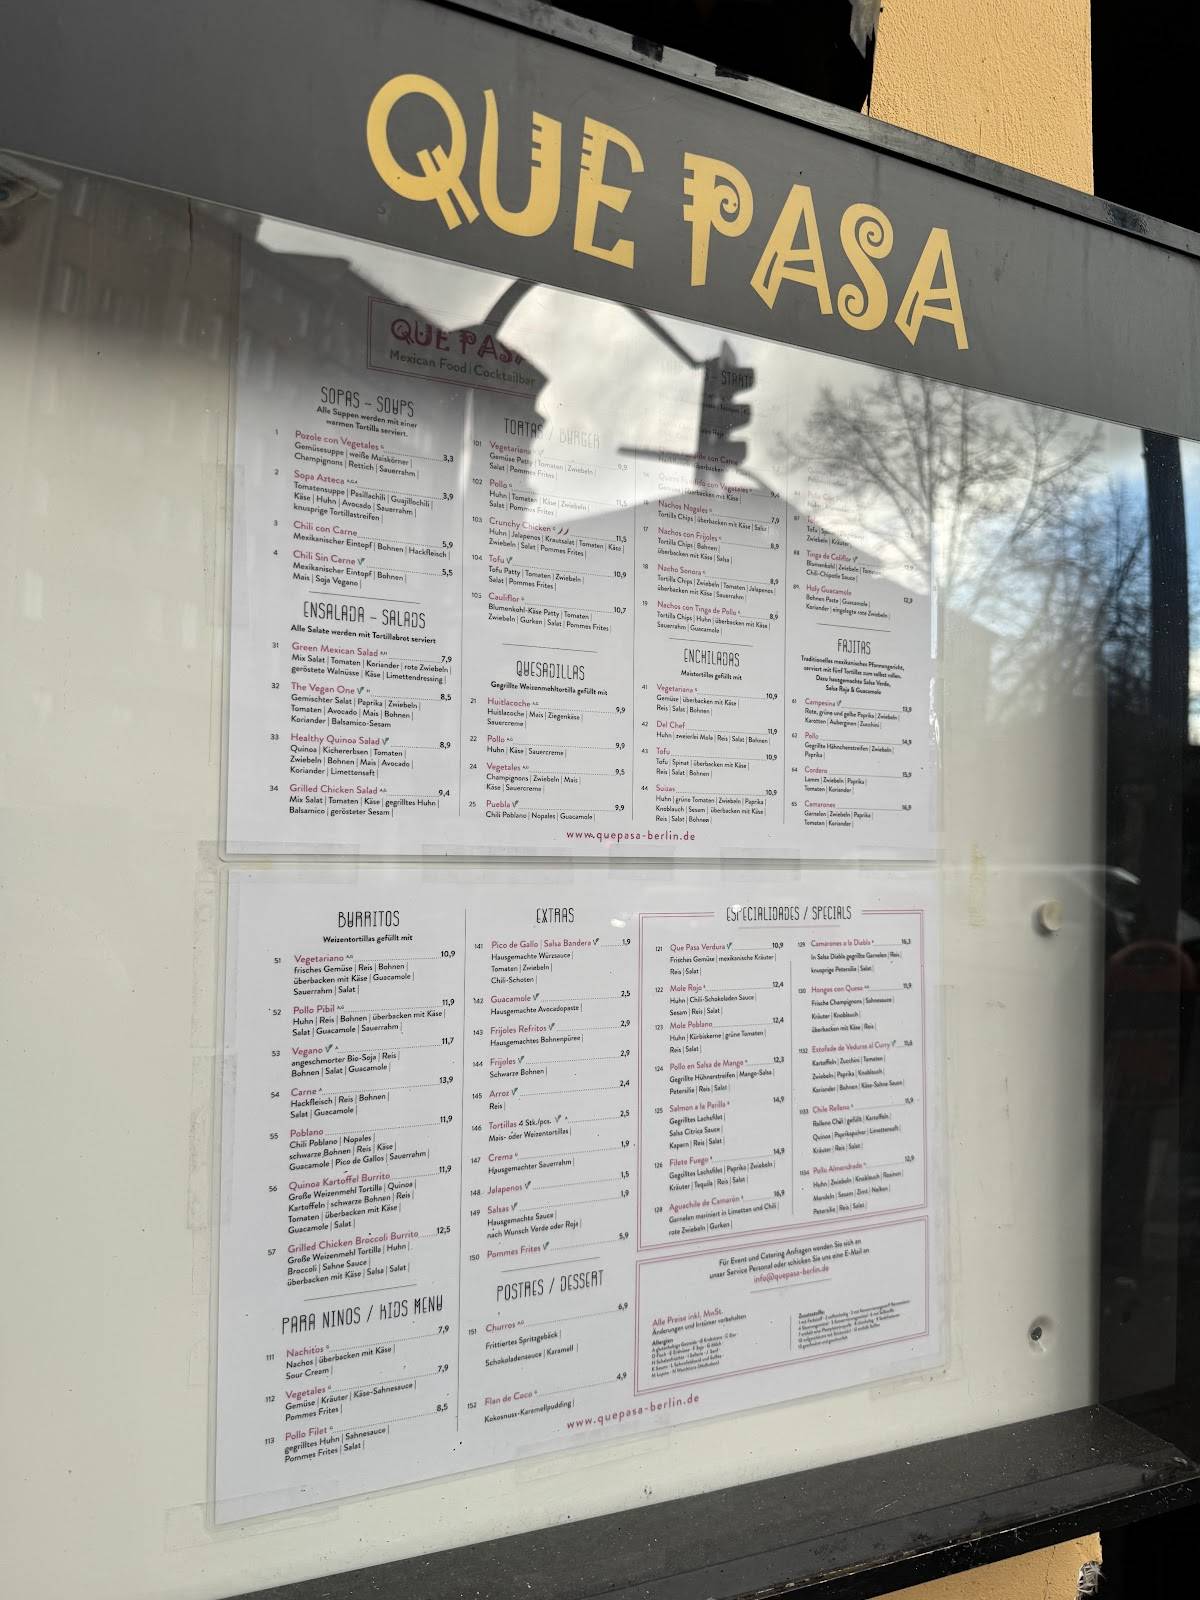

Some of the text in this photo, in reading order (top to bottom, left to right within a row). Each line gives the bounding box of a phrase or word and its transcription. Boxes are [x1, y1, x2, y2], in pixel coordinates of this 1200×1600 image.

[366, 73, 970, 350] QUE PASA
[390, 318, 450, 351] QUE
[390, 349, 536, 386] Mexican Food Cocktailbar
[321, 386, 360, 408] SOPAS
[317, 406, 330, 415] Alle
[333, 408, 358, 419] Suppen
[361, 414, 385, 423] werden
[401, 420, 417, 428] einer
[296, 431, 379, 450] Pozole con Vegetales
[294, 471, 344, 484] Sopa Azteca
[443, 492, 453, 501] 3,9
[294, 521, 357, 536] Chili con Carne
[442, 541, 453, 549] 5,9
[293, 550, 355, 565] Chili Sin Carne
[489, 555, 504, 564] Tofu
[442, 569, 453, 577] 5,5
[489, 592, 519, 602] Cauliflor
[657, 601, 680, 611] Nachos
[695, 604, 710, 616] Tinga
[721, 607, 737, 616] Pollo
[304, 601, 425, 629] ENSALADA SALADS
[770, 613, 778, 621] 8,9
[291, 624, 305, 632] Alle
[307, 626, 329, 635] Salate
[331, 628, 356, 637] werden
[373, 632, 410, 642] Tortillabrot
[411, 636, 436, 644] serviert
[292, 642, 378, 657] Green Mexican Salad
[838, 639, 871, 654] FAJITAS
[684, 648, 740, 668] ENCHILADAS
[517, 660, 584, 680] QUESADILLAS
[291, 682, 355, 695] The Vegan One
[656, 721, 685, 730] Del Chef
[291, 734, 379, 745] Healthy Quinoa Salad
[487, 735, 505, 743] Pollo
[290, 785, 377, 794] Grilled Chicken Salad
[486, 800, 510, 808] Puebla
[615, 804, 624, 812] 9,9
[567, 830, 696, 843] www.quepasa-berlin.de
[537, 908, 574, 923] EXTRAS
[726, 906, 800, 921] ESPECIALIDADES
[812, 906, 851, 920] SPECIALS
[338, 911, 400, 928] BURRITOS
[323, 936, 374, 944] Weizentortillas
[377, 935, 399, 943] gefüllt
[773, 941, 783, 949] 10,9
[670, 944, 684, 952] Que
[702, 943, 725, 951] Verdura
[295, 954, 344, 966] Vegetariano
[670, 983, 702, 992] Mole Rojo
[491, 996, 531, 1004] Guacamole
[294, 1005, 334, 1014] Pollo Pibil
[491, 1005, 579, 1016] Hausgemachte Avocadopaste
[491, 1025, 546, 1036] Frijoles Refritos
[292, 1047, 323, 1057] Vegano
[670, 1062, 685, 1070] Pollo
[697, 1061, 712, 1069] Salsa
[714, 1060, 722, 1068] de
[723, 1059, 742, 1068] Mango
[439, 1076, 453, 1084] 13,9
[291, 1088, 316, 1097] Carne
[489, 1090, 509, 1098] Arroz
[489, 1121, 517, 1130] Tortillas
[290, 1128, 323, 1137] Poblano
[670, 1156, 708, 1167] Filete Fuego
[289, 1173, 390, 1191] Quinoa Kartoffel Burrito
[488, 1206, 509, 1214] Salsas
[437, 1226, 451, 1235] 12,5
[288, 1231, 418, 1253] Grilled Chicken Broccoli Burrito
[487, 1246, 540, 1259] Pommes Frites
[497, 1279, 544, 1302] POSTRES
[561, 1270, 604, 1292] DESSERT
[618, 1303, 628, 1311] 6,9
[283, 1314, 315, 1335] PARA
[323, 1307, 360, 1329] NINOS
[380, 1300, 408, 1320] KIDS
[438, 1325, 449, 1334] 7,9
[486, 1322, 515, 1332] Churros
[286, 1345, 324, 1358] Nachitos
[437, 1404, 448, 1412] 8,5
[567, 1394, 700, 1430] www.quepasa-berlin.de
[285, 1428, 327, 1441] Pollo Filet
